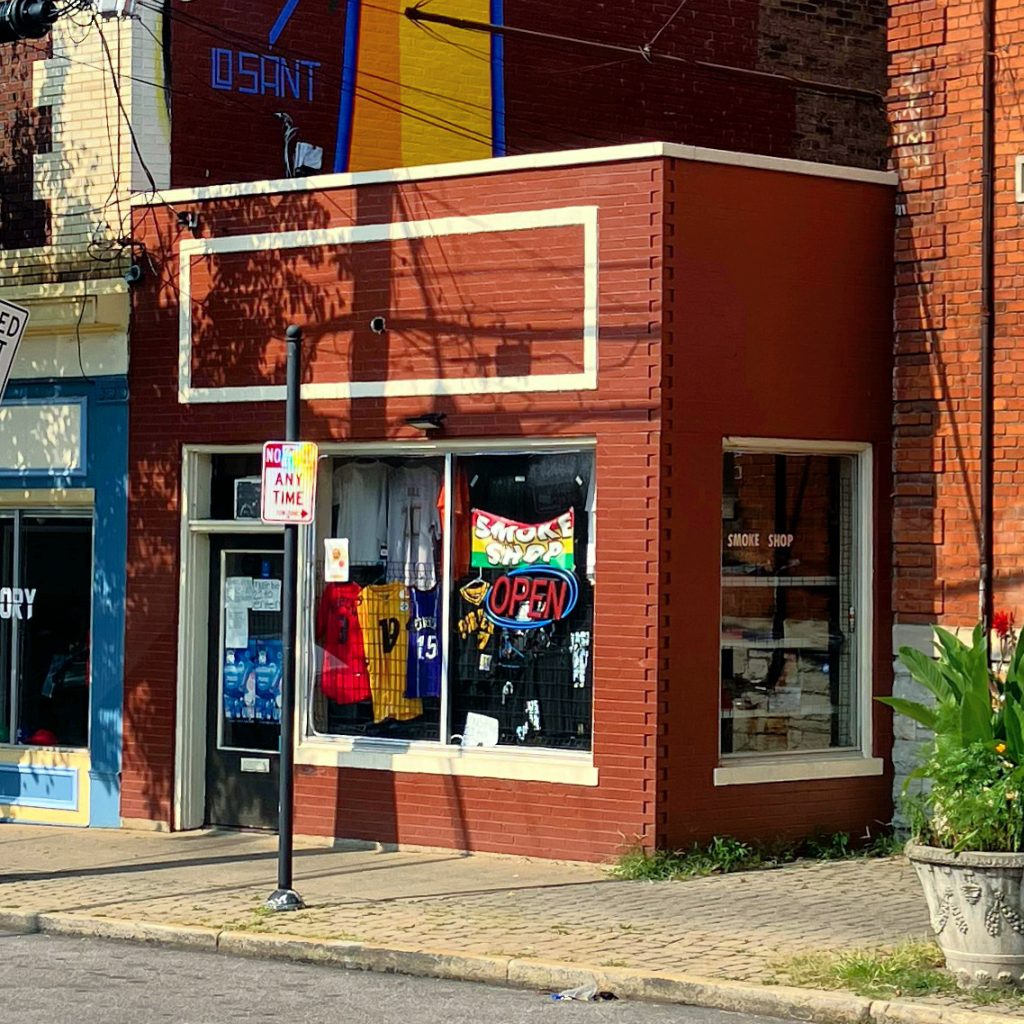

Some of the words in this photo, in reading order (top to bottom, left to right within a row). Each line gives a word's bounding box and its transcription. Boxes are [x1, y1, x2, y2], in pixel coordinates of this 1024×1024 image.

[275, 472, 302, 486] ANY
[273, 490, 303, 505] TIME
[474, 513, 573, 544] SMOKE
[727, 532, 760, 547] SMOKE
[768, 533, 794, 548] SHOP
[485, 540, 565, 566] SHOP
[490, 575, 568, 621] OPEN
